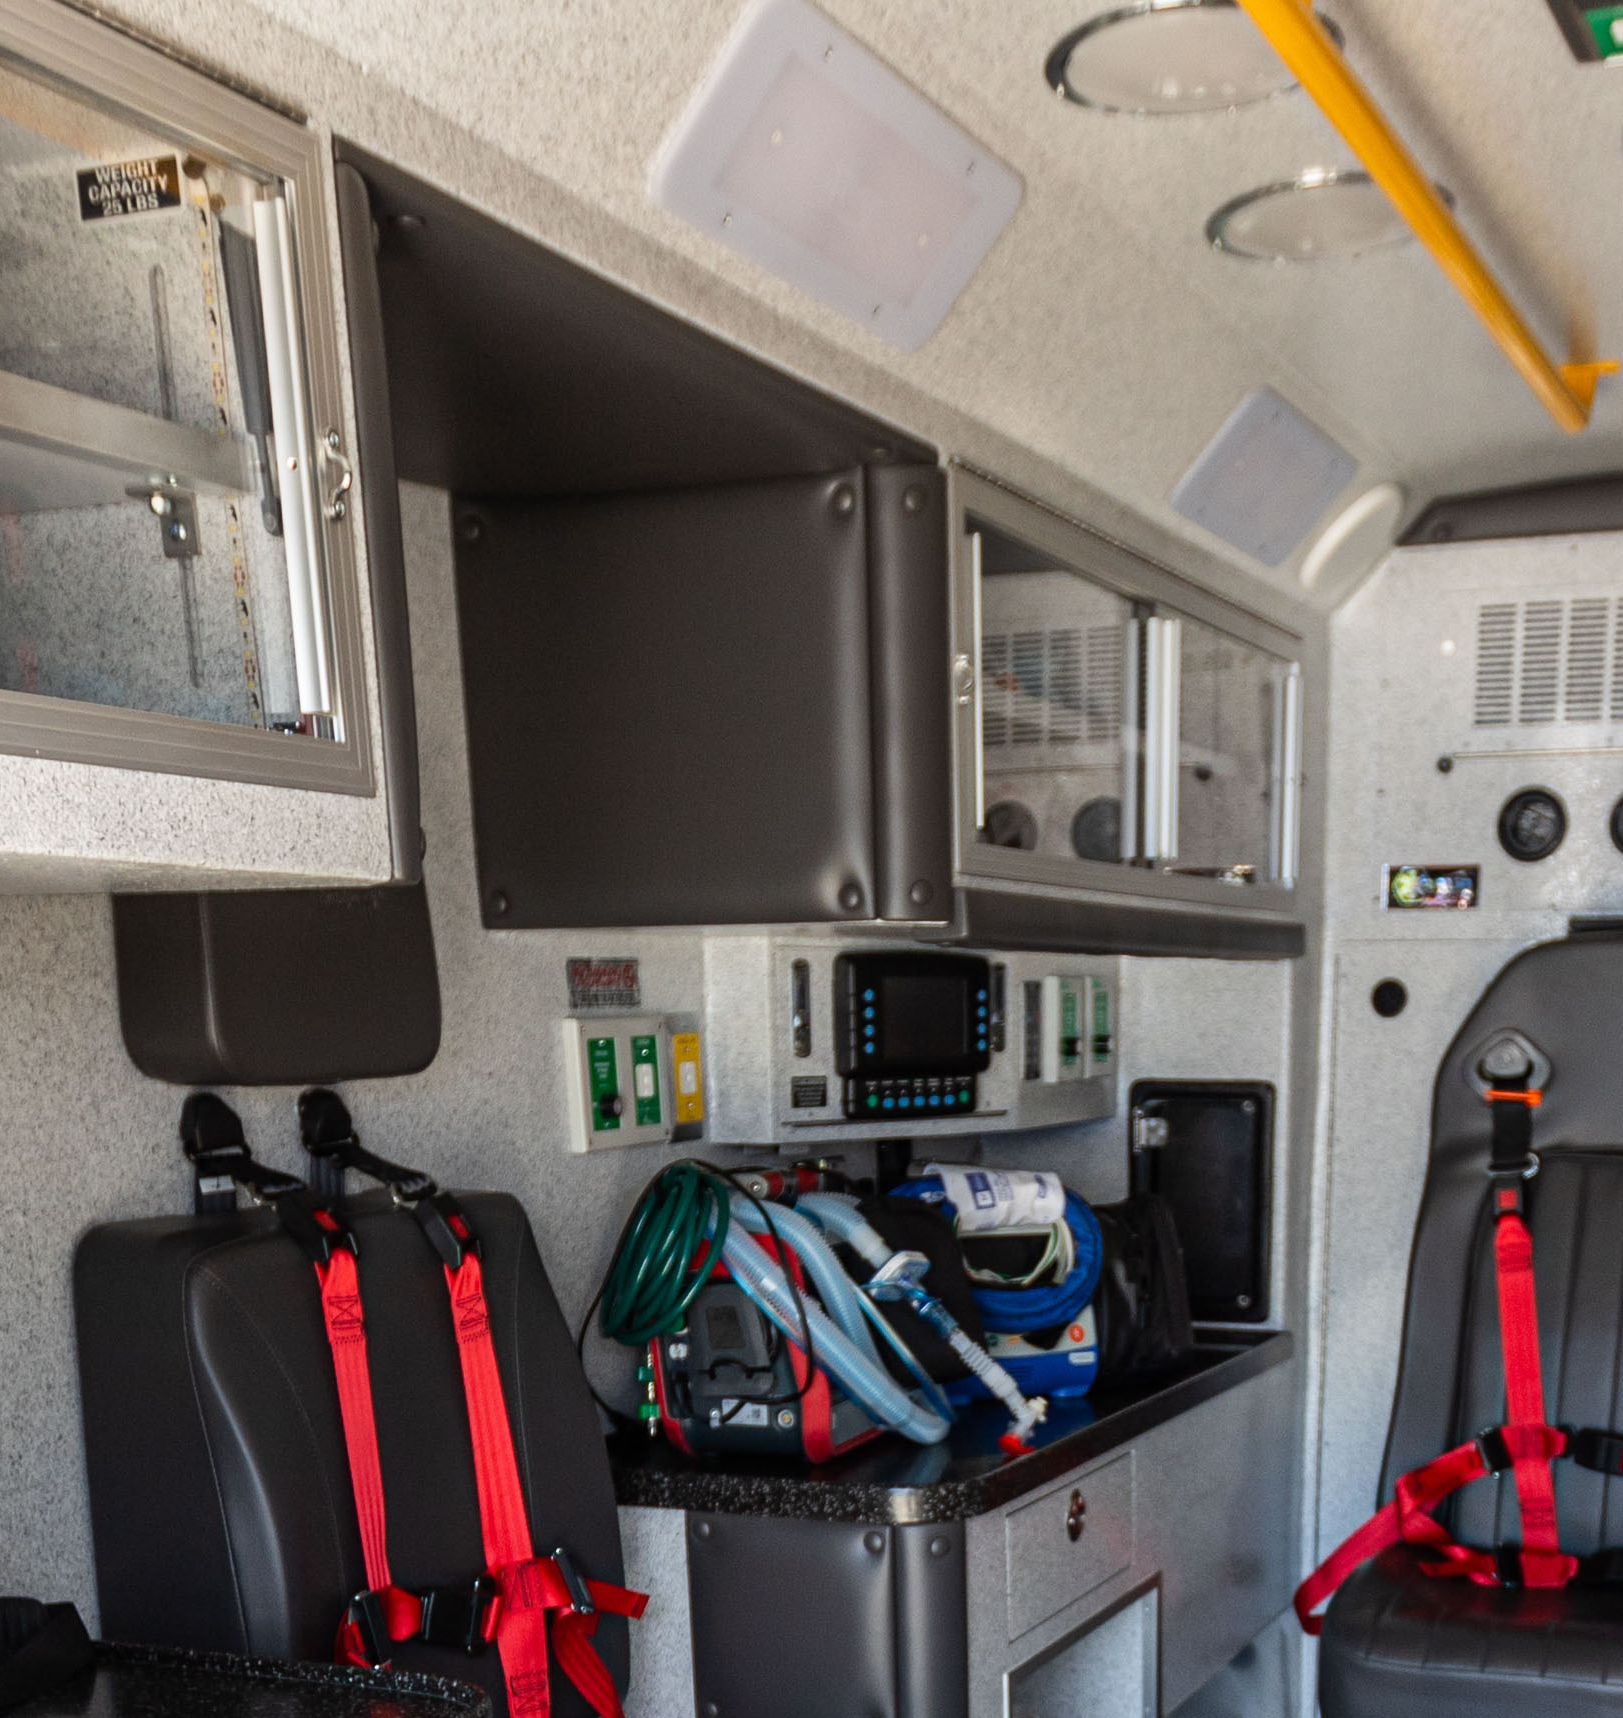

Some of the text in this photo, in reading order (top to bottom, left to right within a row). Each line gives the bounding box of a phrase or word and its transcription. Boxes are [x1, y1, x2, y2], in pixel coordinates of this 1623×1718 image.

[94, 159, 158, 185] WEIGHT
[88, 173, 168, 205] CAPACITY
[102, 192, 159, 217] 25 LBS
